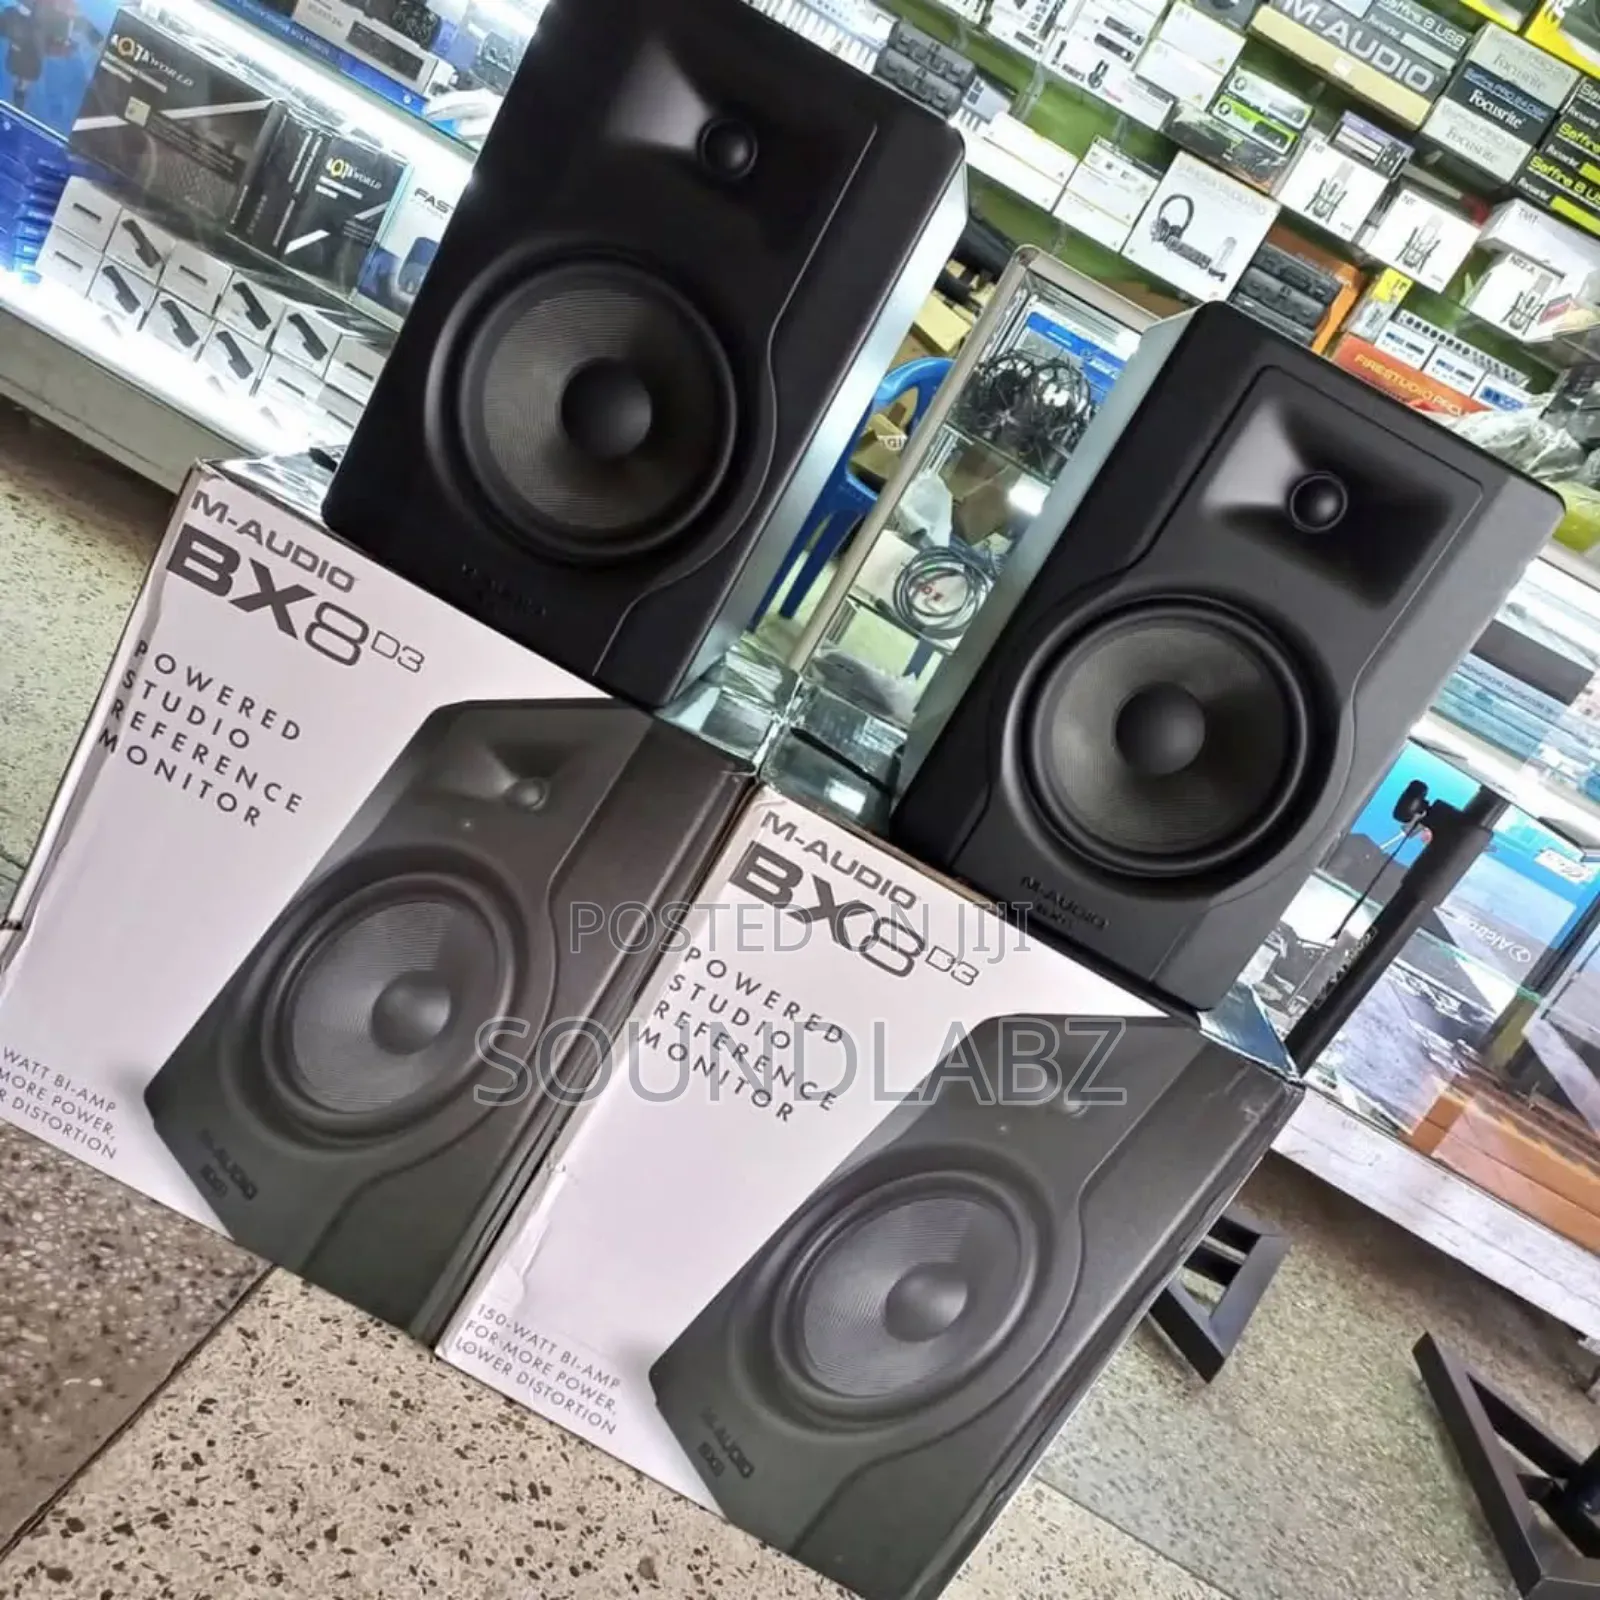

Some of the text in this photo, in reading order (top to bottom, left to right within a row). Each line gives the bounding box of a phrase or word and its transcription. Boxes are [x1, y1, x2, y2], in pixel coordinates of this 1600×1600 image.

[1281, 0, 1435, 93] M-AUDIO
[1435, 24, 1467, 47] USB
[1469, 88, 1524, 130] Focusrite
[1530, 155, 1574, 187] Saffire
[191, 488, 356, 594] M-AUDIO
[165, 522, 370, 666] BX8
[370, 630, 426, 674] D3
[122, 668, 251, 749] STUDIO
[134, 639, 301, 741] POWERED
[97, 729, 262, 827] MONITOR
[111, 698, 303, 814] REFERENCE
[760, 809, 917, 911] M-AUDIO
[728, 839, 926, 979] BX8
[669, 973, 791, 1051] STUDIO
[684, 945, 846, 1045] POWERED
[0, 1067, 115, 1140] MORE POWER,
[3, 1046, 116, 1112] WATT BI-AMP
[637, 1027, 795, 1122] MONITOR
[653, 1000, 838, 1112] REFERENCE
[11, 1096, 117, 1159] DISTORTION
[455, 1336, 617, 1436] LOWER DISTORTION
[465, 1319, 617, 1416] FOR MORE POWER,
[476, 1303, 621, 1391] 150-WATT BI-AMP
